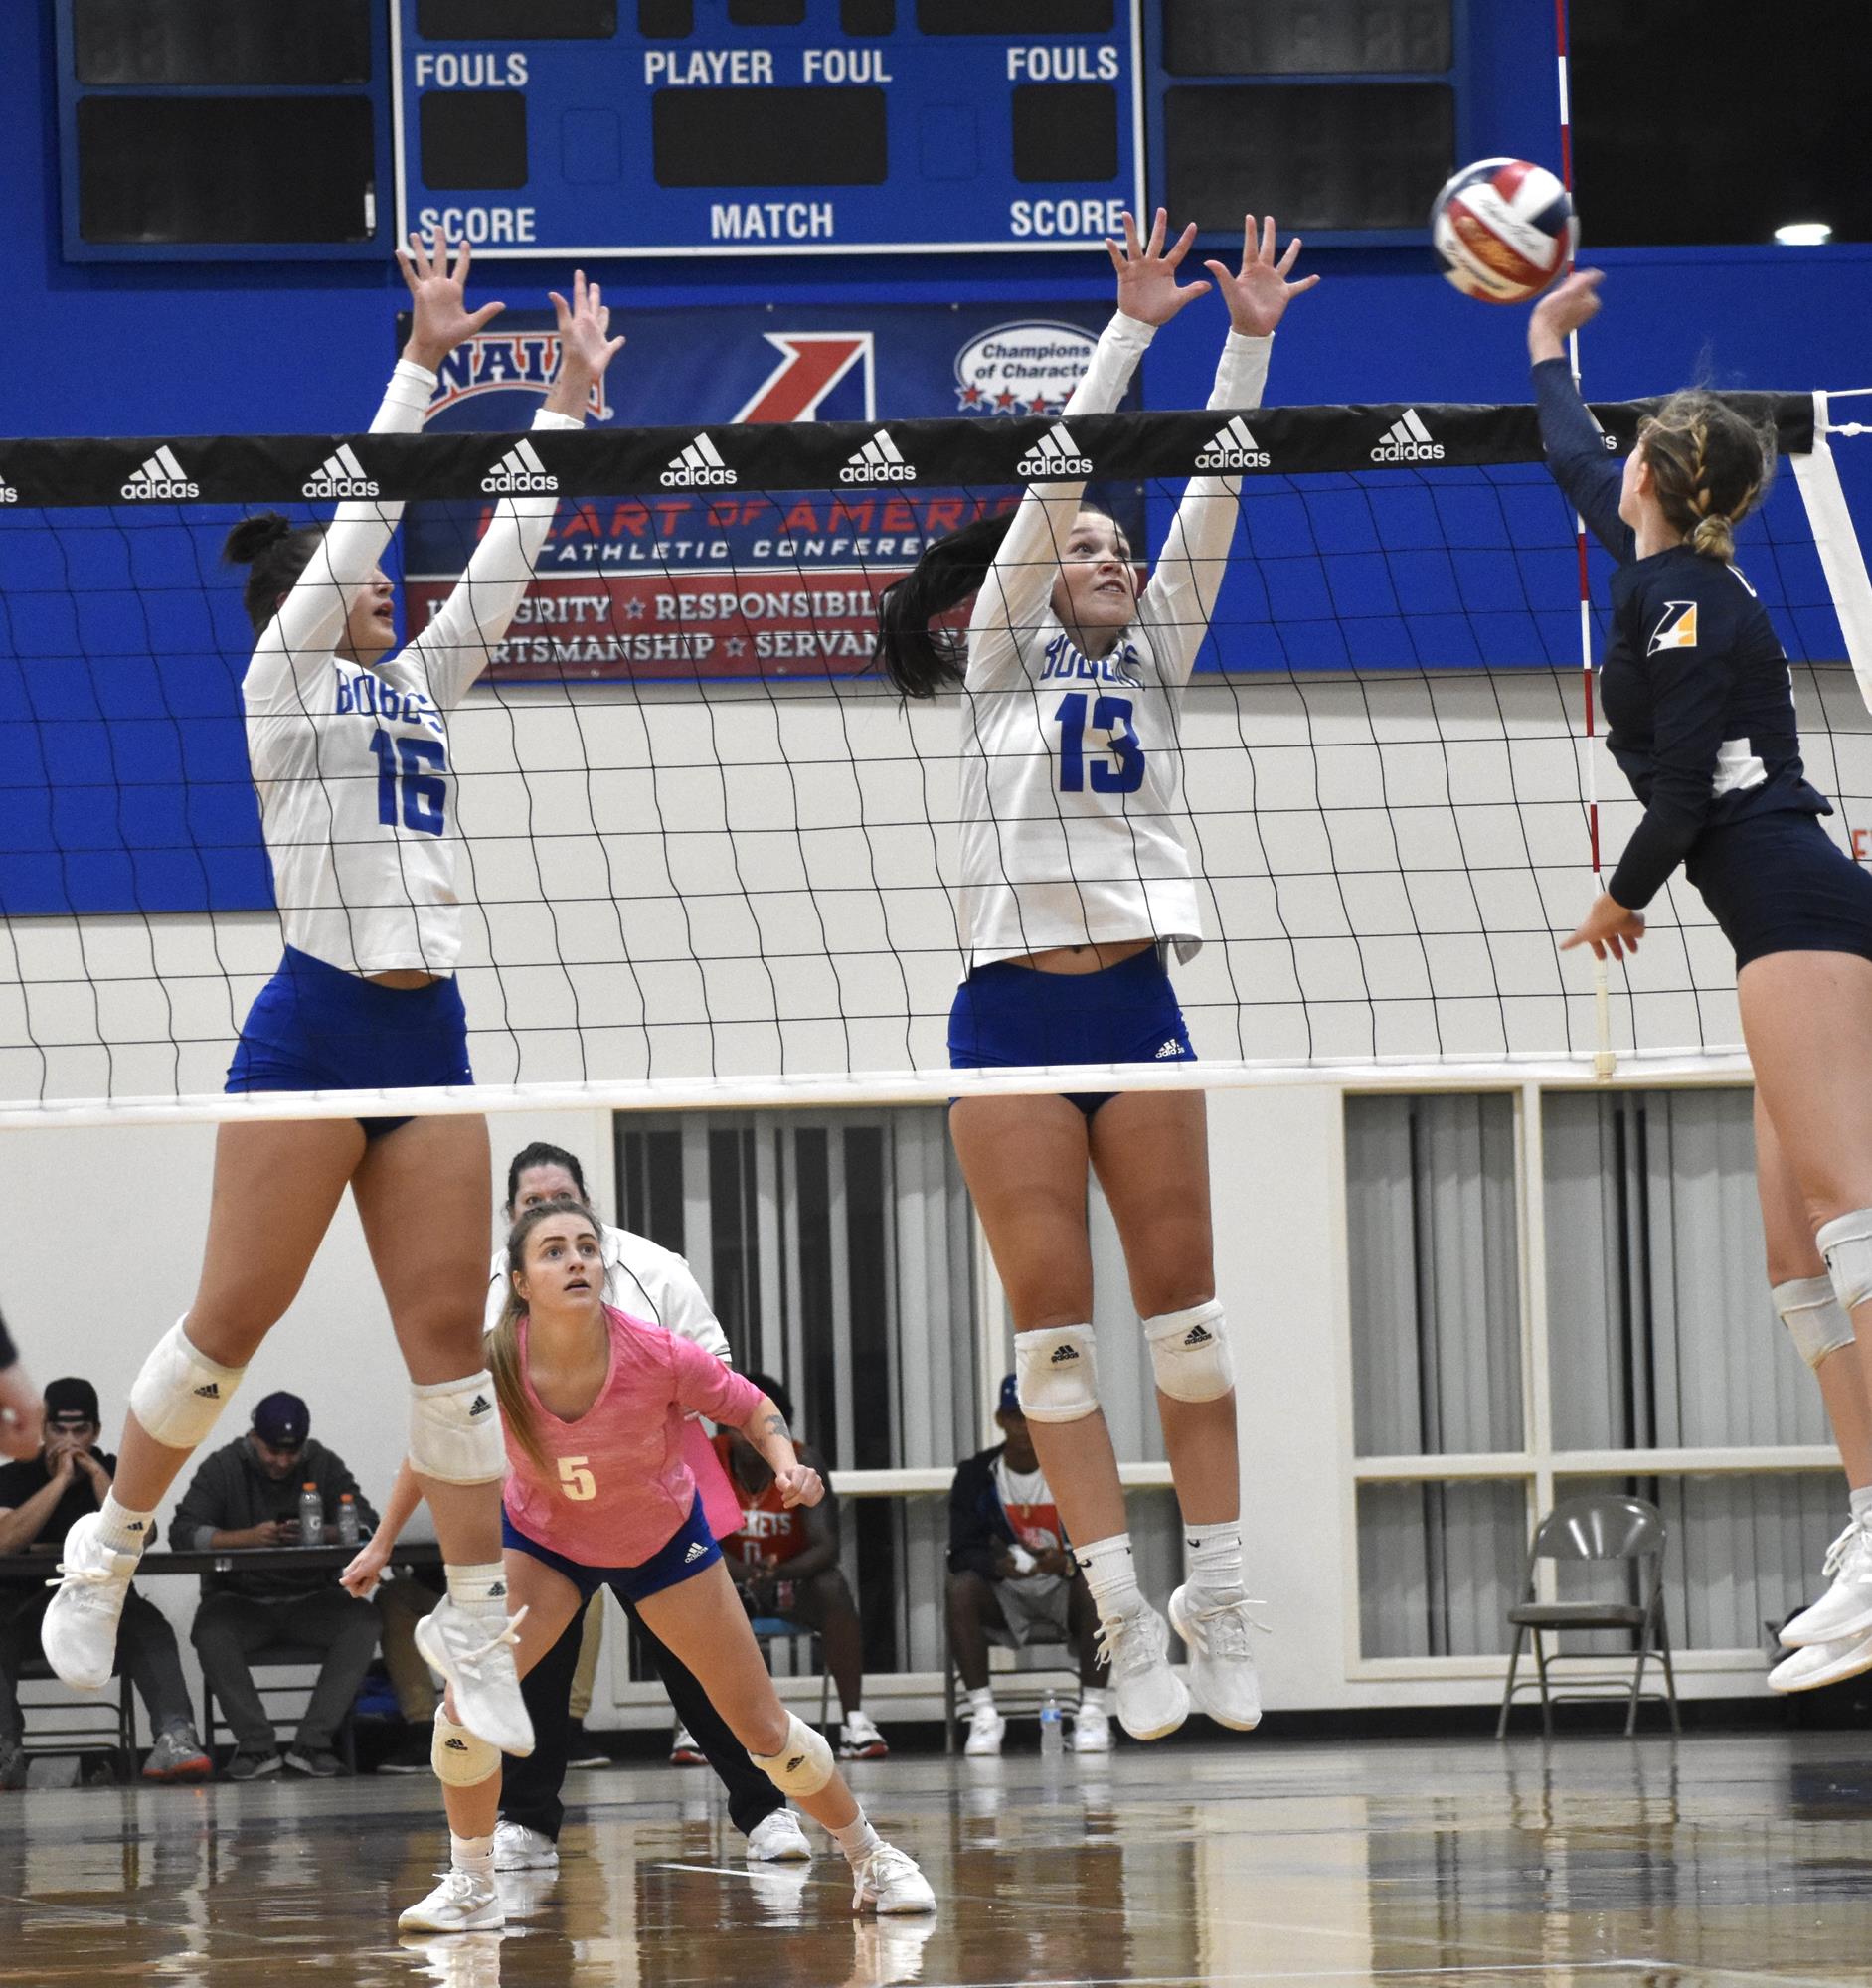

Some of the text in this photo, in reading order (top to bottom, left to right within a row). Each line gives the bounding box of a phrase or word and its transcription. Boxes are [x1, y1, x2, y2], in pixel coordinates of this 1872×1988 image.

[416, 53, 529, 87] FOULS
[644, 49, 893, 85] PLAYER FOUL
[1007, 46, 1119, 81] FOULS
[418, 207, 537, 244] SCORE
[711, 202, 834, 239] MATCH
[1010, 199, 1125, 237] SCORE
[981, 343, 1091, 360] Champions
[975, 363, 1090, 379] of Characte
[1194, 447, 1271, 469] adidas
[1370, 440, 1446, 462] adidas
[659, 464, 738, 487] adidas
[839, 459, 917, 483] adidas
[1016, 453, 1094, 476] adidas
[120, 477, 200, 500] adidas
[301, 476, 380, 497] adidas
[480, 471, 559, 493] adidas
[707, 499, 772, 527] OF
[558, 540, 730, 561] ATHLETIC
[1054, 692, 1146, 794] 13
[369, 728, 447, 837] 16
[1183, 1333, 1212, 1346] adidas
[1051, 1352, 1079, 1364] adidas
[557, 1455, 596, 1501] 5
